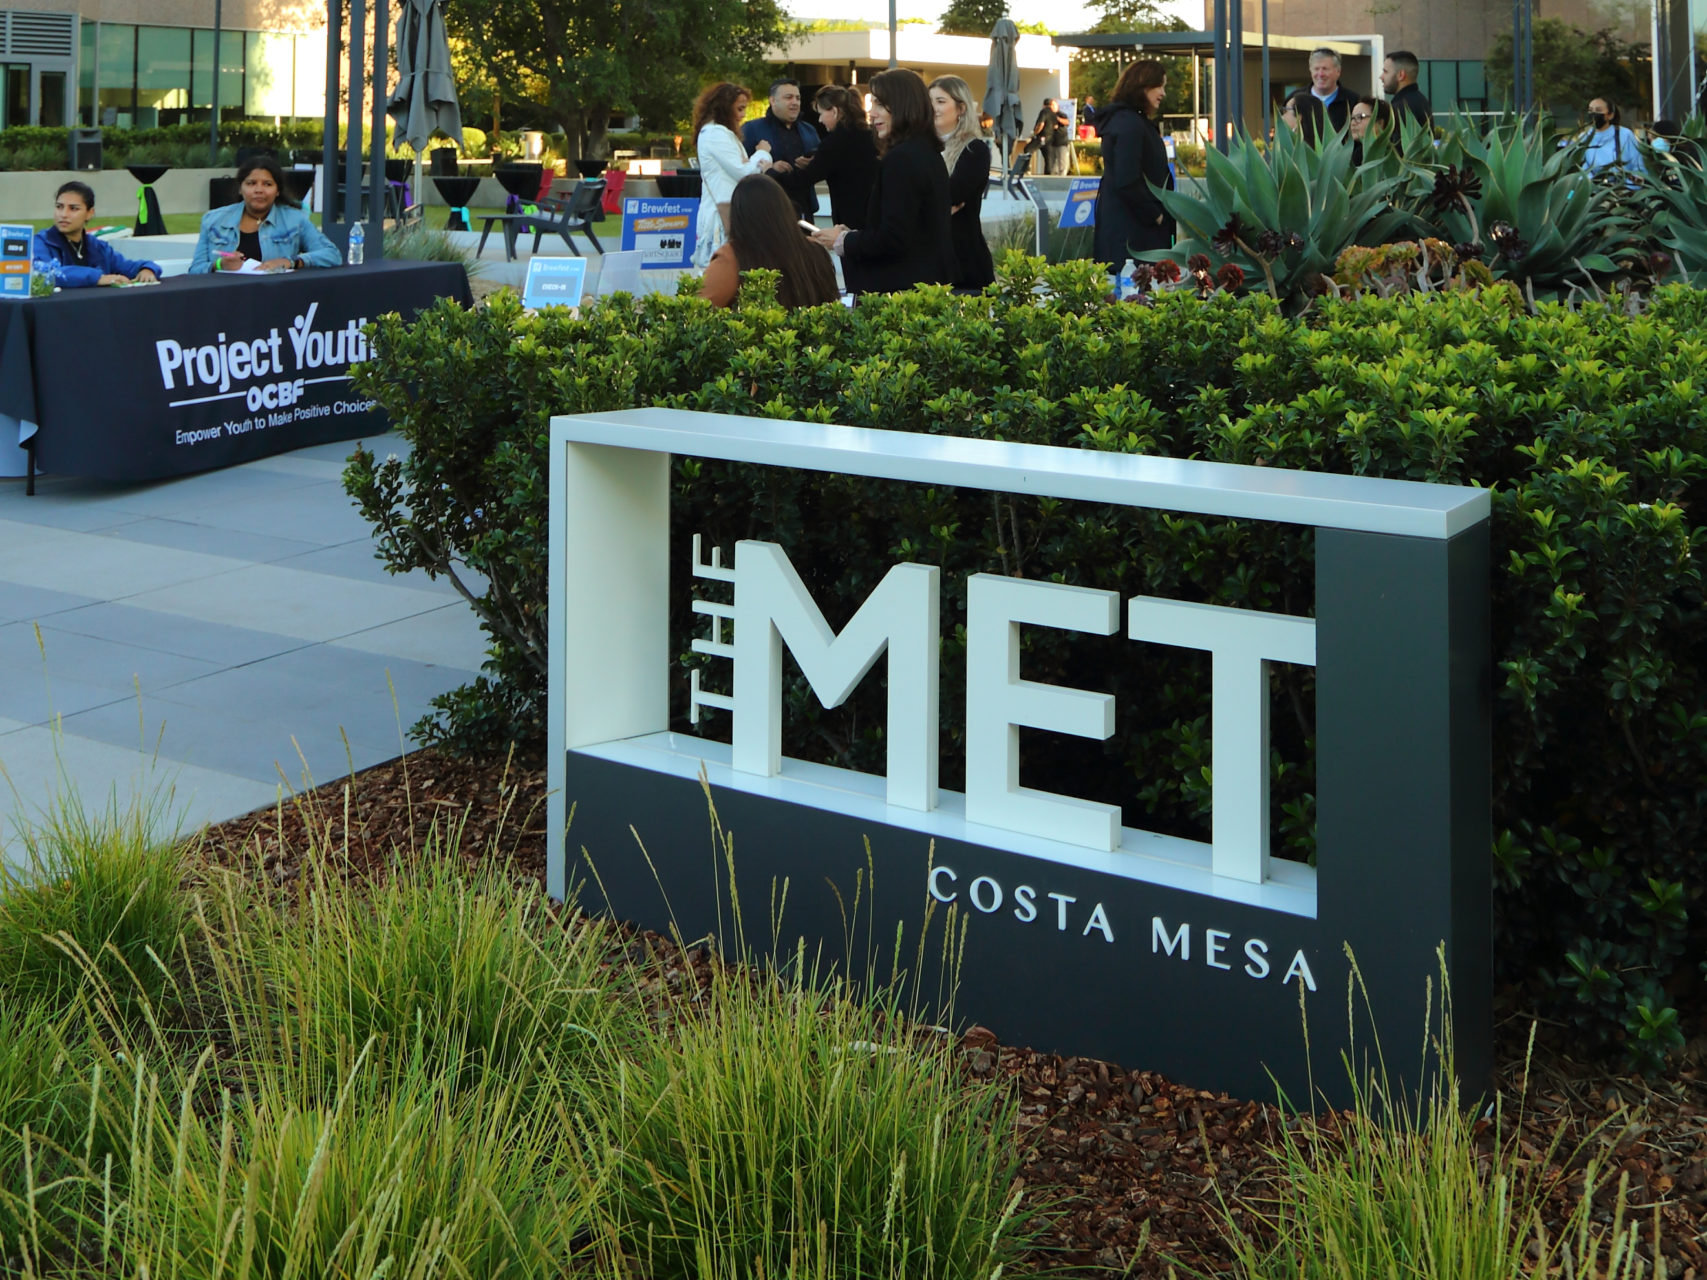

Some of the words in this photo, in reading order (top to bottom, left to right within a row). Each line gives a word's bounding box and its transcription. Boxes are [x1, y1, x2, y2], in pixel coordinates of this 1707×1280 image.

[641, 202, 681, 214] Brewfest
[156, 328, 283, 393] Project
[247, 378, 305, 412] OCBF
[176, 425, 222, 446] Empower
[224, 419, 253, 436] Youth
[254, 416, 265, 429] to
[268, 411, 293, 427] Make
[294, 403, 331, 421] Positive
[732, 539, 1316, 885] MET
[929, 866, 1114, 944] COSTA
[1152, 916, 1317, 992] MESA
